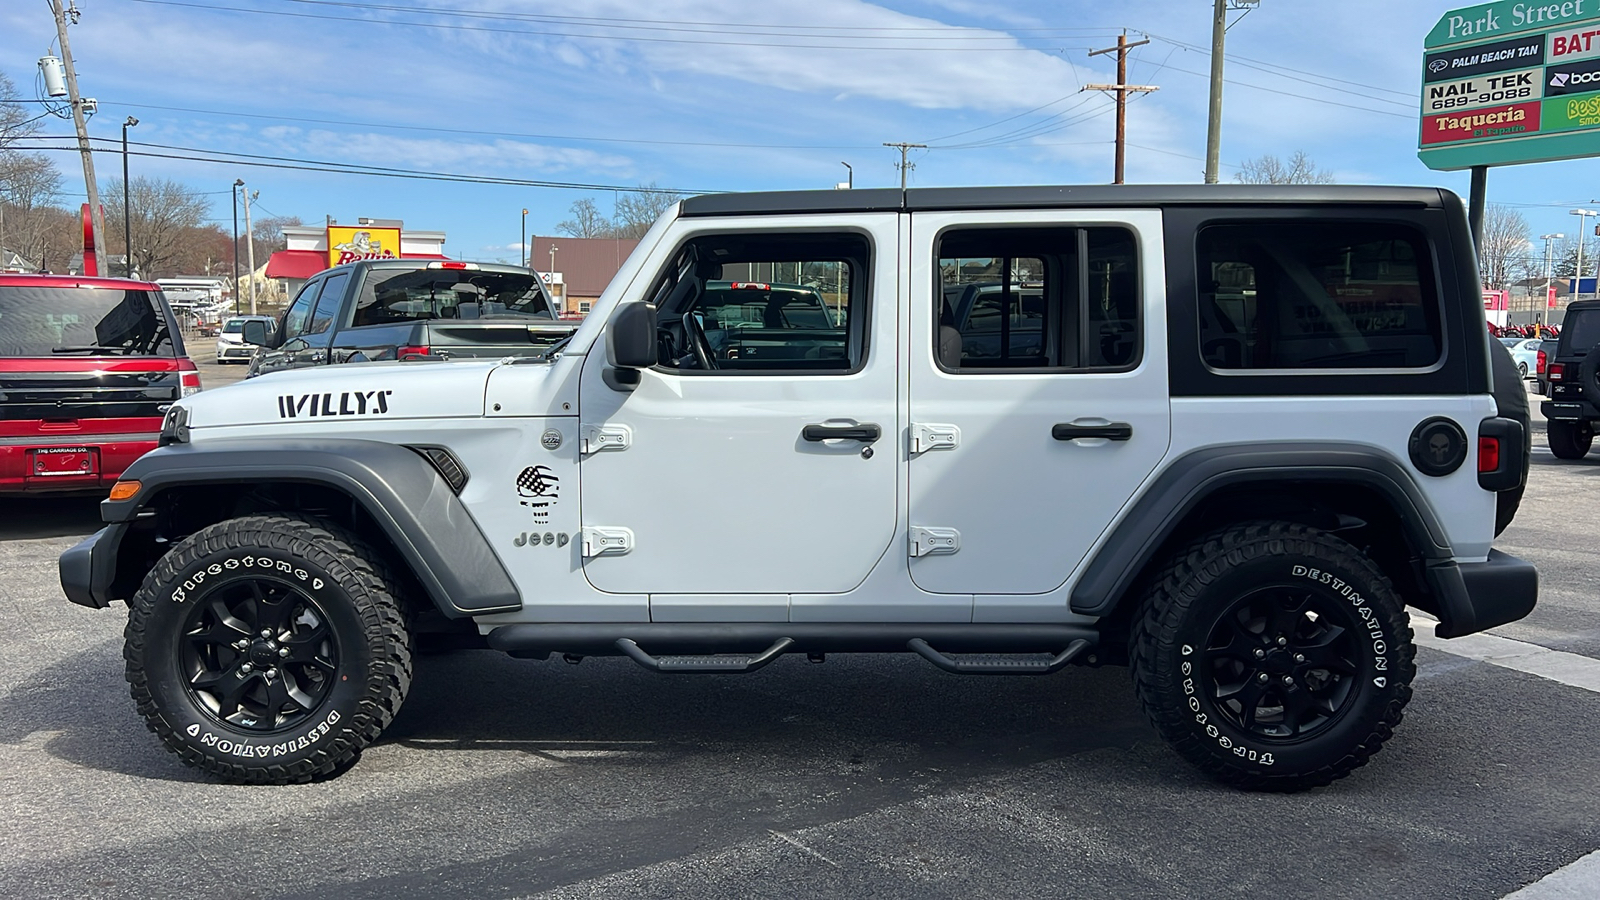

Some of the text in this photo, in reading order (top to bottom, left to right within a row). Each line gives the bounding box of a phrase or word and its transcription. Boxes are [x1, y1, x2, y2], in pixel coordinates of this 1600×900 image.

[1448, 0, 1583, 38] Park Street
[1452, 45, 1539, 68] PALM BEACH TAN
[1553, 31, 1600, 56] BAT
[1430, 72, 1533, 99] NAIL TEK
[1432, 87, 1531, 109] 689-9088
[278, 390, 392, 418] WILLYS
[513, 532, 569, 548] Jeep
[172, 556, 308, 602] Firestone
[1292, 565, 1387, 670] DESTINATION
[1182, 661, 1274, 765] Firestone
[201, 709, 341, 757] DESTINATION
